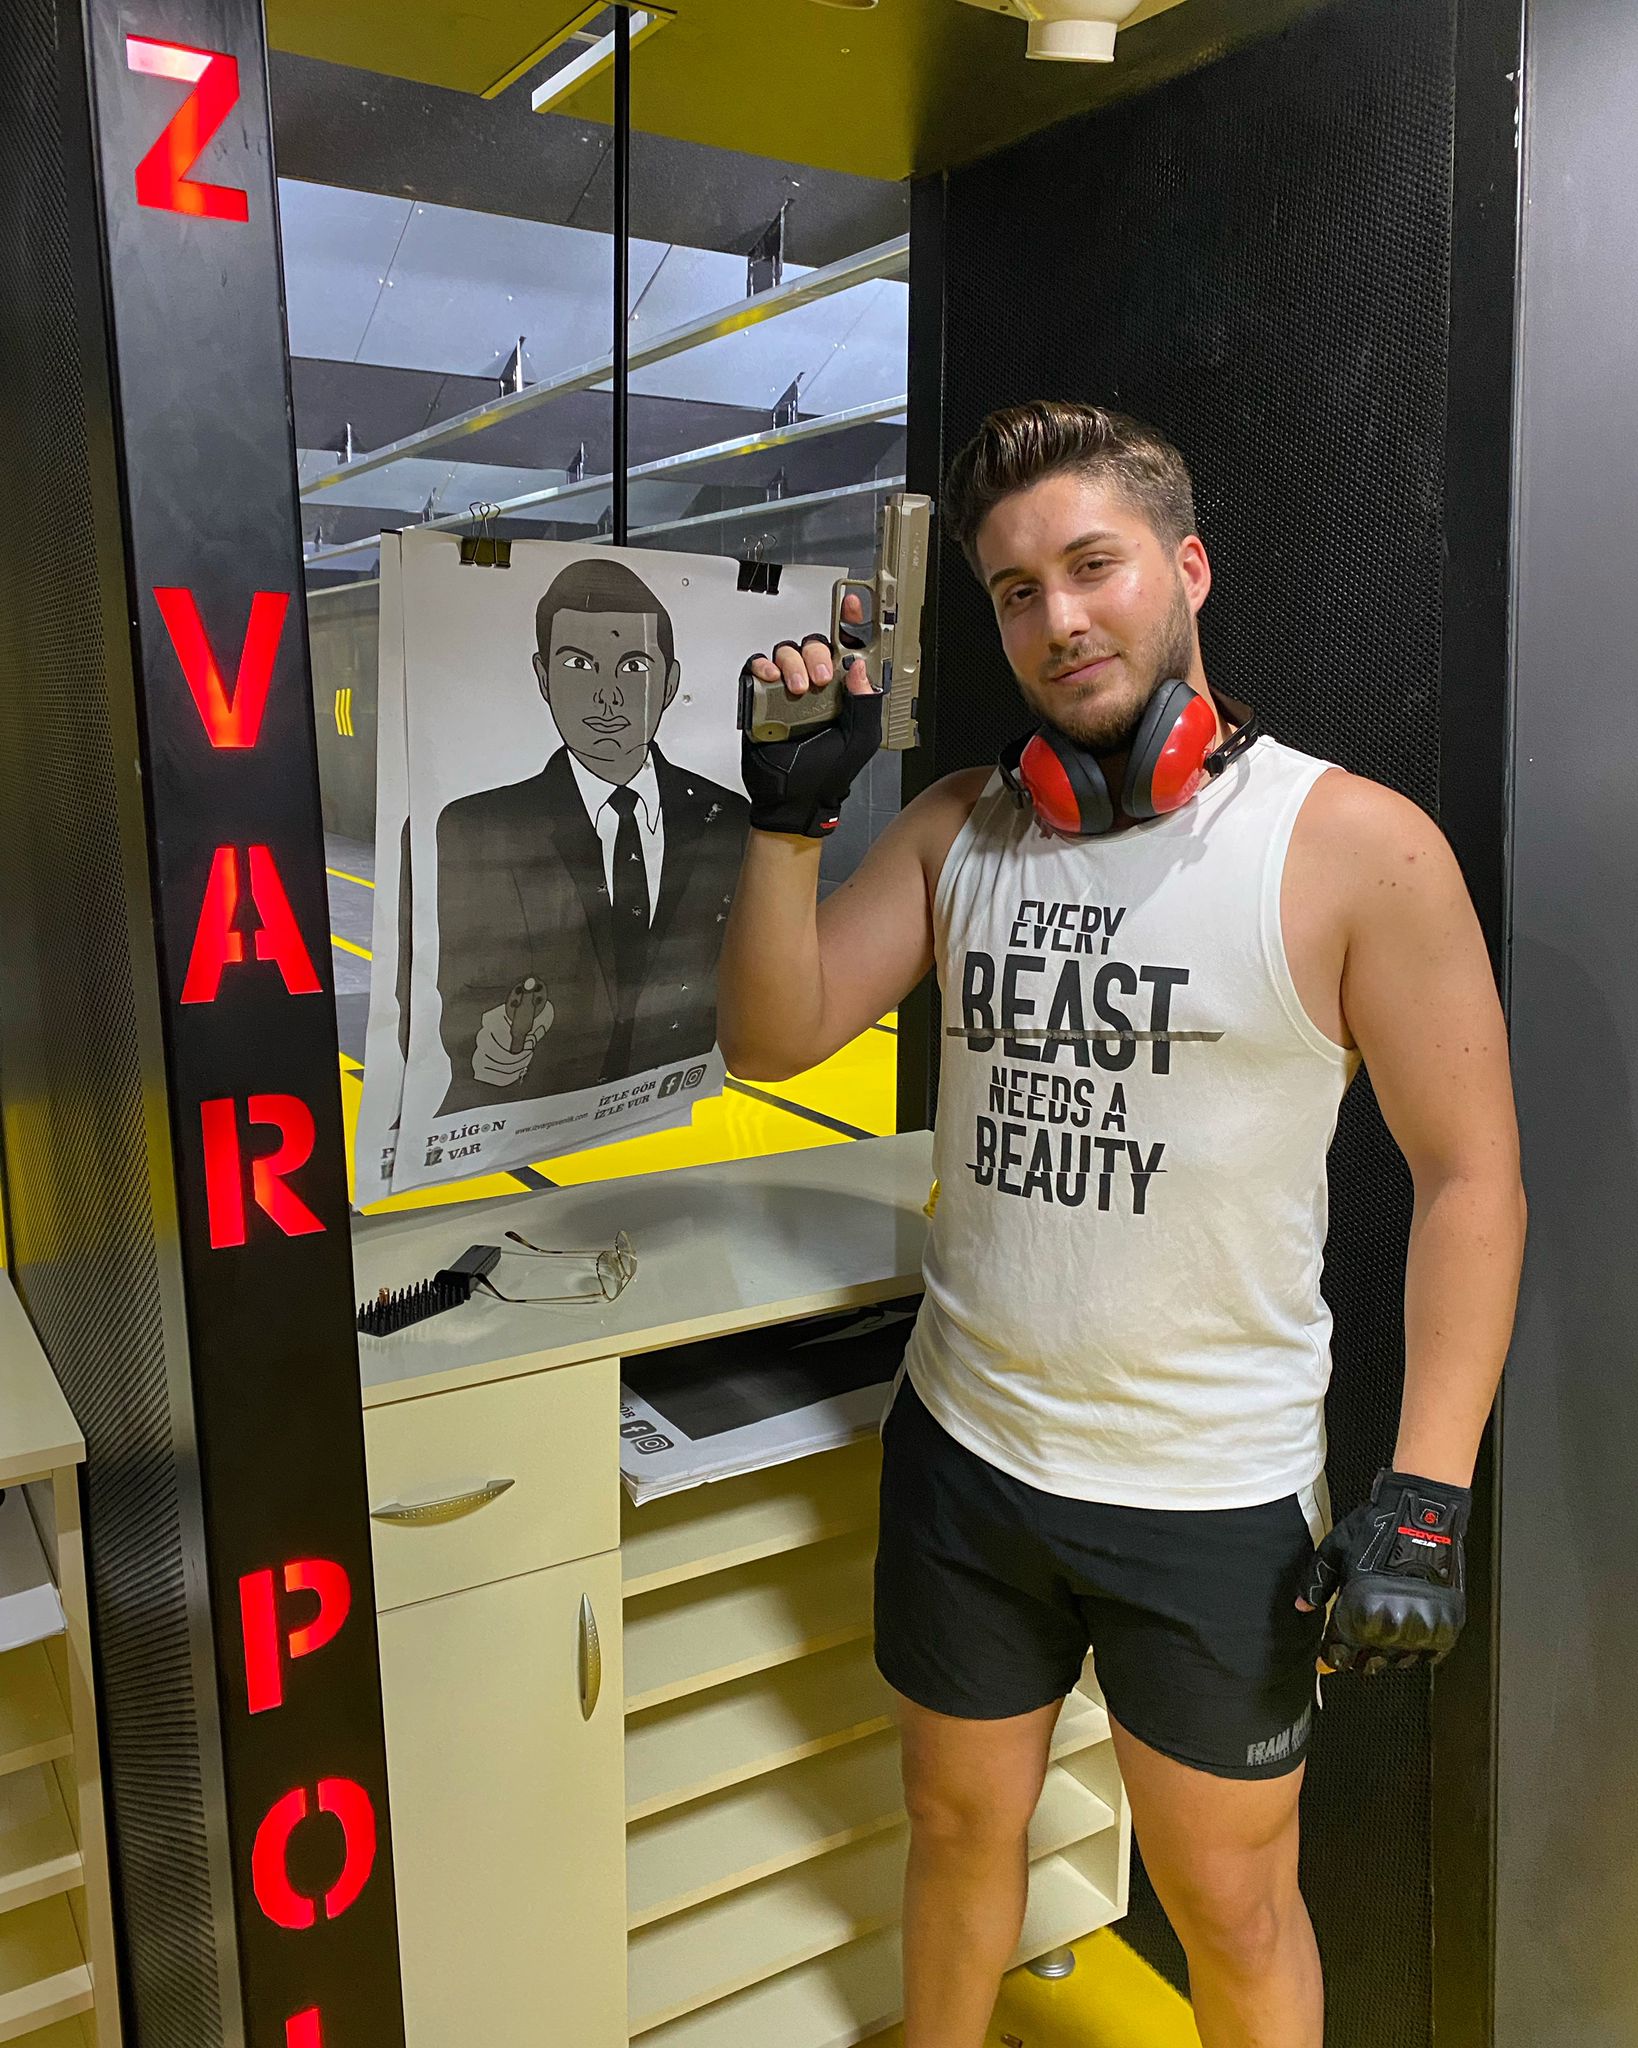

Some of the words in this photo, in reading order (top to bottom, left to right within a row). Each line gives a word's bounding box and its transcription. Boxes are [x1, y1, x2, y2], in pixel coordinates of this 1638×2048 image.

[153, 588, 326, 1250] VAR
[1009, 900, 1127, 955] EVERY
[962, 951, 1190, 1075] BEAST
[627, 1094, 650, 1109] VUR
[631, 1080, 656, 1097] GÖR
[989, 1065, 1095, 1128] NEEDS
[1101, 1082, 1127, 1132] A
[447, 1142, 482, 1161] VAR
[965, 1115, 1168, 1215] BEAUTY
[239, 1559, 376, 2048] PO
